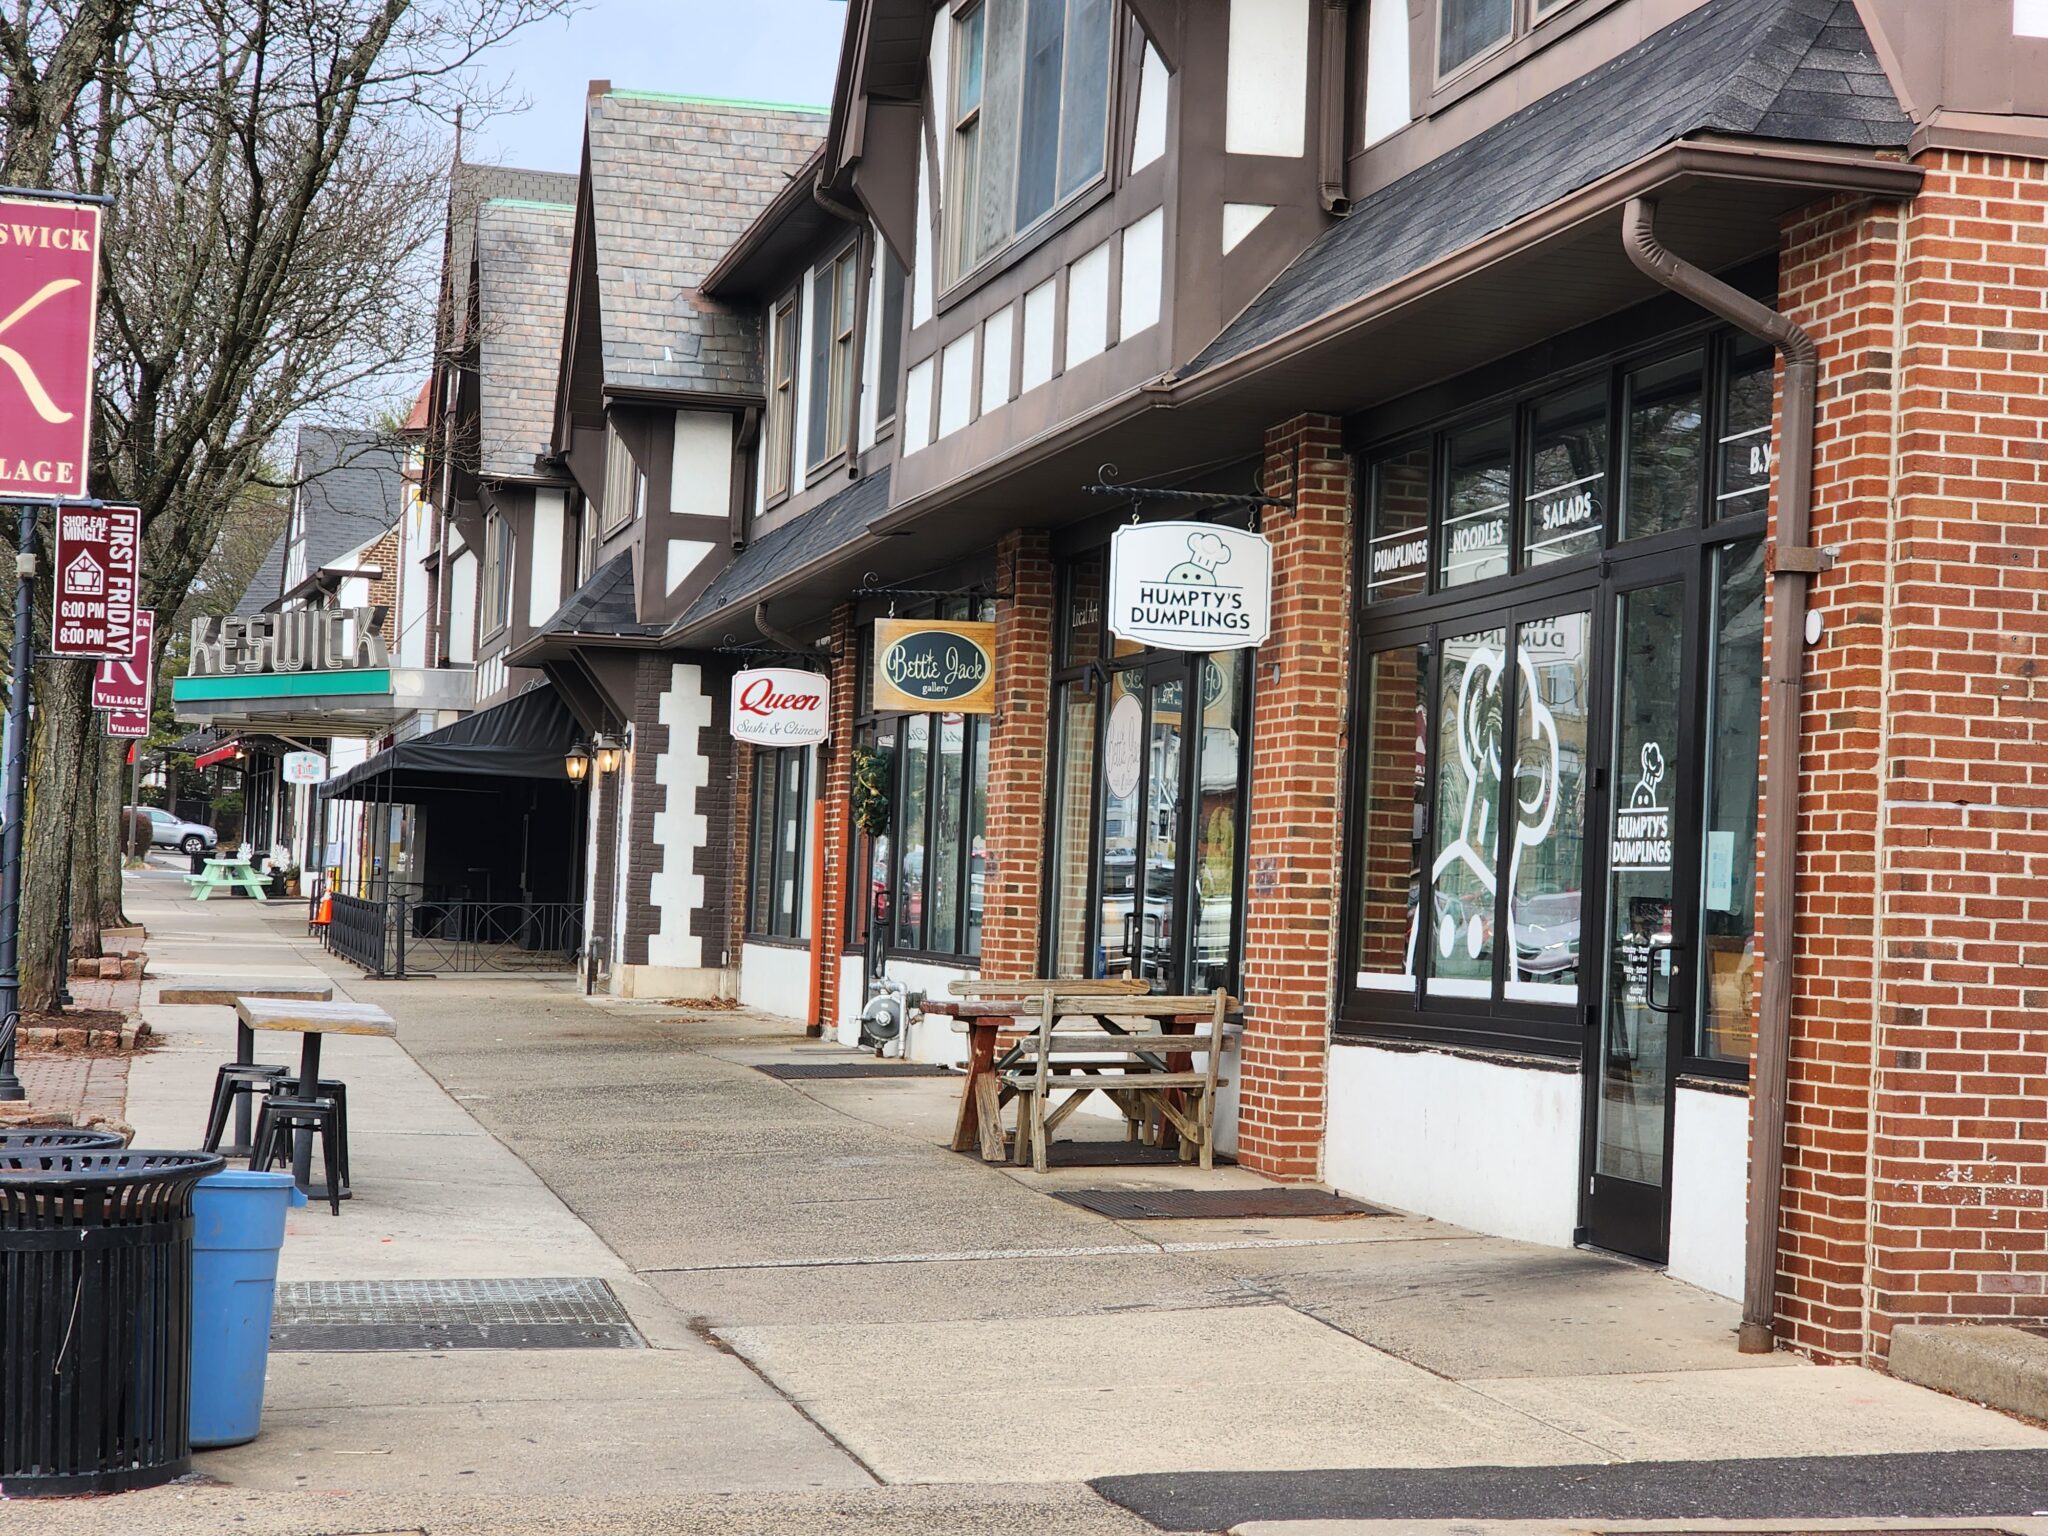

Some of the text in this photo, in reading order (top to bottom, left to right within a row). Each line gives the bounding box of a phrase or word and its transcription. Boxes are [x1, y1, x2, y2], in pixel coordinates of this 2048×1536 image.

[1542, 491, 1593, 531] SALADS
[63, 526, 108, 544] MINGLE
[1452, 518, 1504, 555] NOODLES
[1373, 538, 1429, 574] DUMPLINGS
[106, 513, 135, 653] FIRST FRIDAY
[61, 600, 105, 619] 6:00 PM
[1140, 587, 1242, 609] HUMPTY'S
[1130, 606, 1250, 630] DUMPLINGS
[60, 627, 104, 646] 8:00 PM
[189, 605, 385, 677] KESWICK
[887, 645, 985, 685] Bettie Jack
[739, 678, 821, 716] Queen
[922, 682, 949, 695] gallery
[736, 719, 822, 736] Sushi & Chinese
[1617, 814, 1668, 839] HUMPTY'S
[1612, 839, 1672, 864] DUMPLINGS
